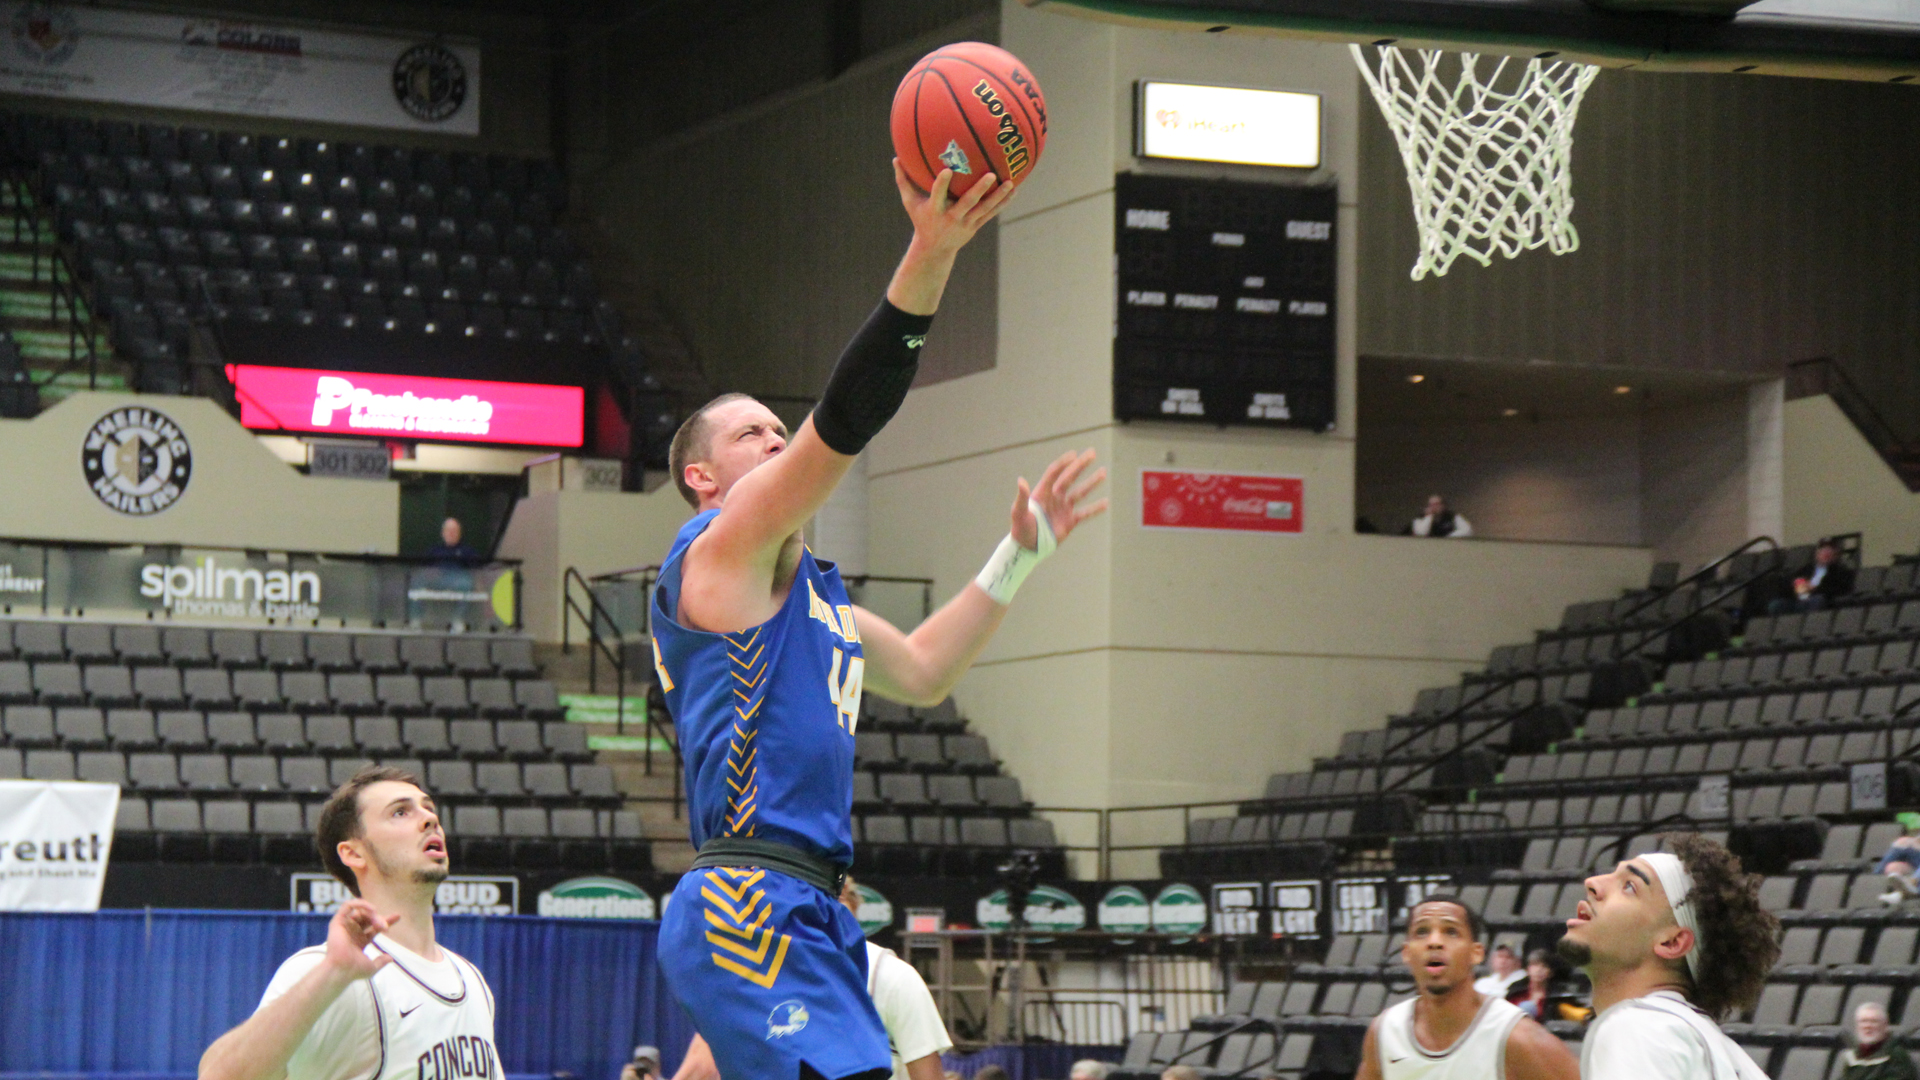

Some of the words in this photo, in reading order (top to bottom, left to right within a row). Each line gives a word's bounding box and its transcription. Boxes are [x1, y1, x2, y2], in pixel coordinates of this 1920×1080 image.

[1011, 68, 1047, 136] NCAA
[972, 79, 1029, 179] Wilson
[1188, 117, 1246, 133] iHeart
[1126, 209, 1170, 230] HOME
[1285, 221, 1331, 240] GUEST
[86, 408, 188, 458] WHEELING
[94, 476, 180, 513] NAILERS
[140, 557, 320, 607] spilman
[175, 599, 246, 615] thomas
[249, 600, 263, 617] &
[265, 601, 320, 618] battle
[828, 646, 865, 736] 44
[310, 881, 350, 904] BU
[435, 883, 500, 906] BUD
[538, 891, 654, 918] Generations
